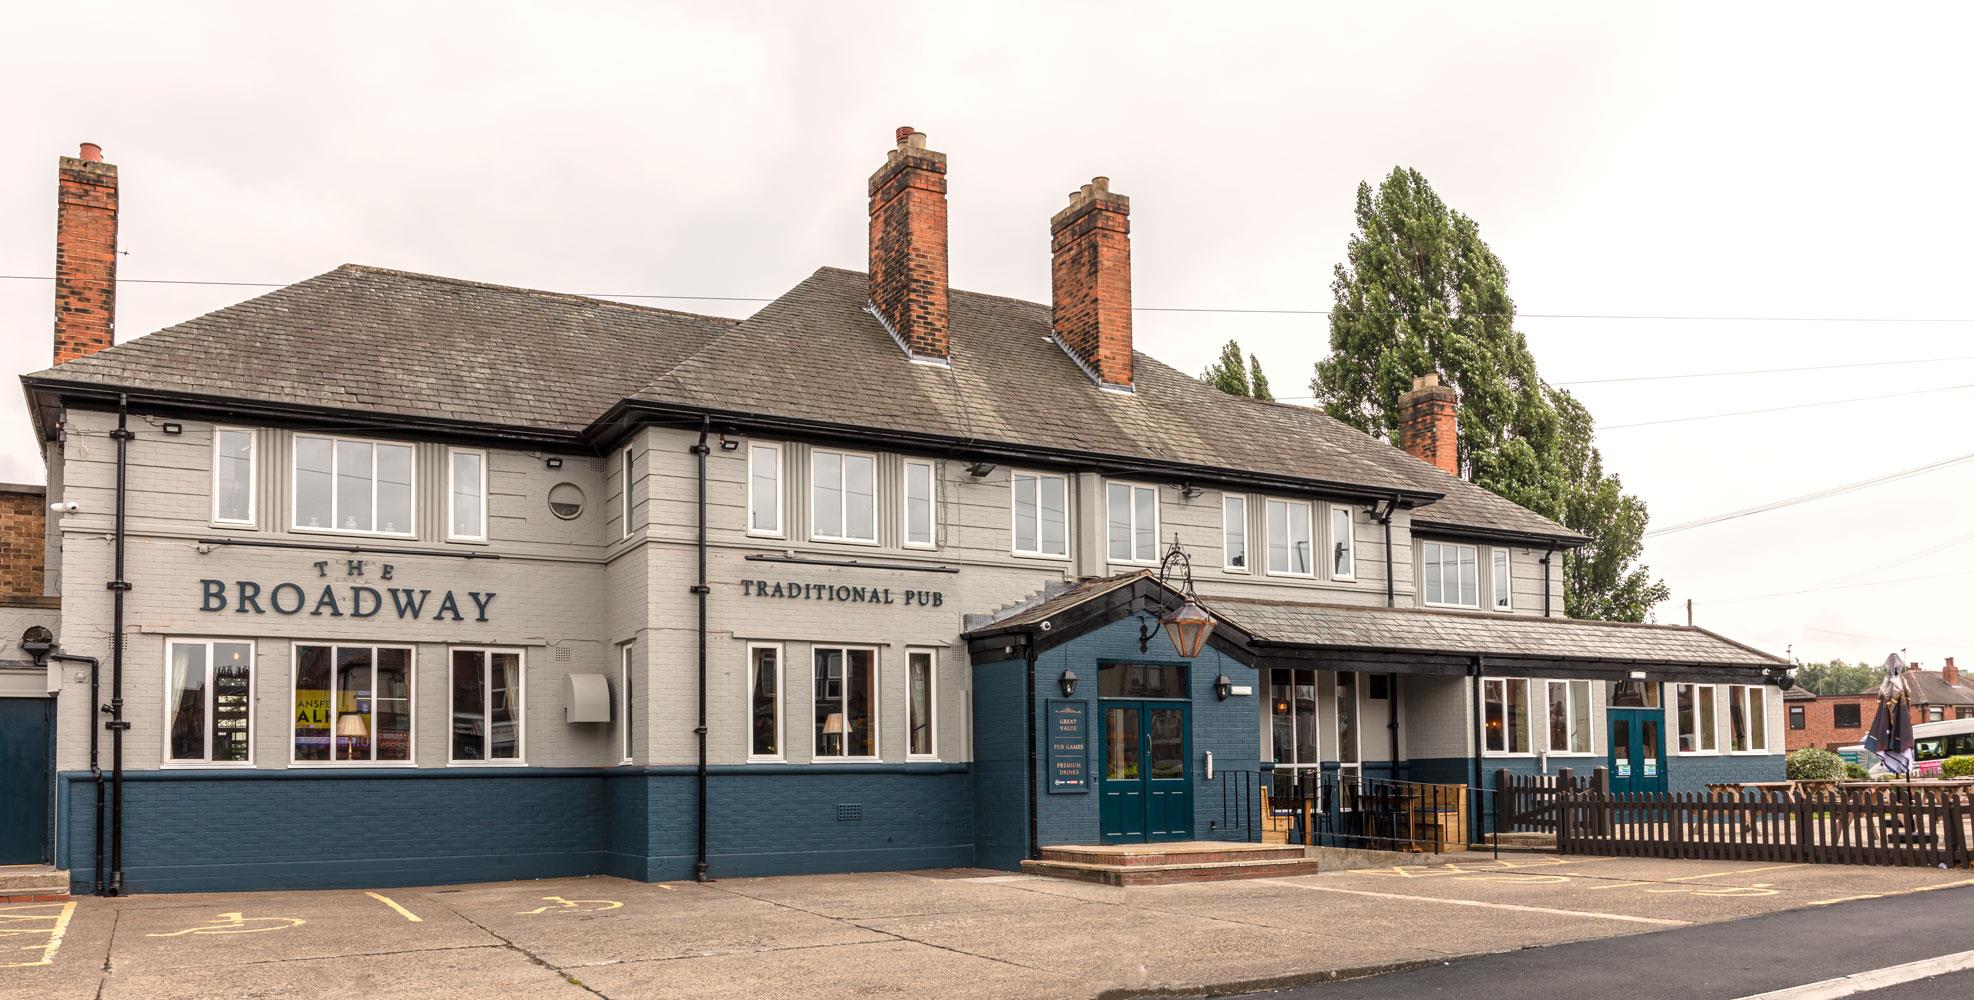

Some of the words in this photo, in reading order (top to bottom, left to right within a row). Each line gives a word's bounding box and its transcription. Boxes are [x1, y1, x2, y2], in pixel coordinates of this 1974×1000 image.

[314, 560, 394, 580] THE
[199, 579, 496, 622] BROADWAY
[741, 580, 894, 604] TRADITIONAL
[905, 590, 943, 607] PUB
